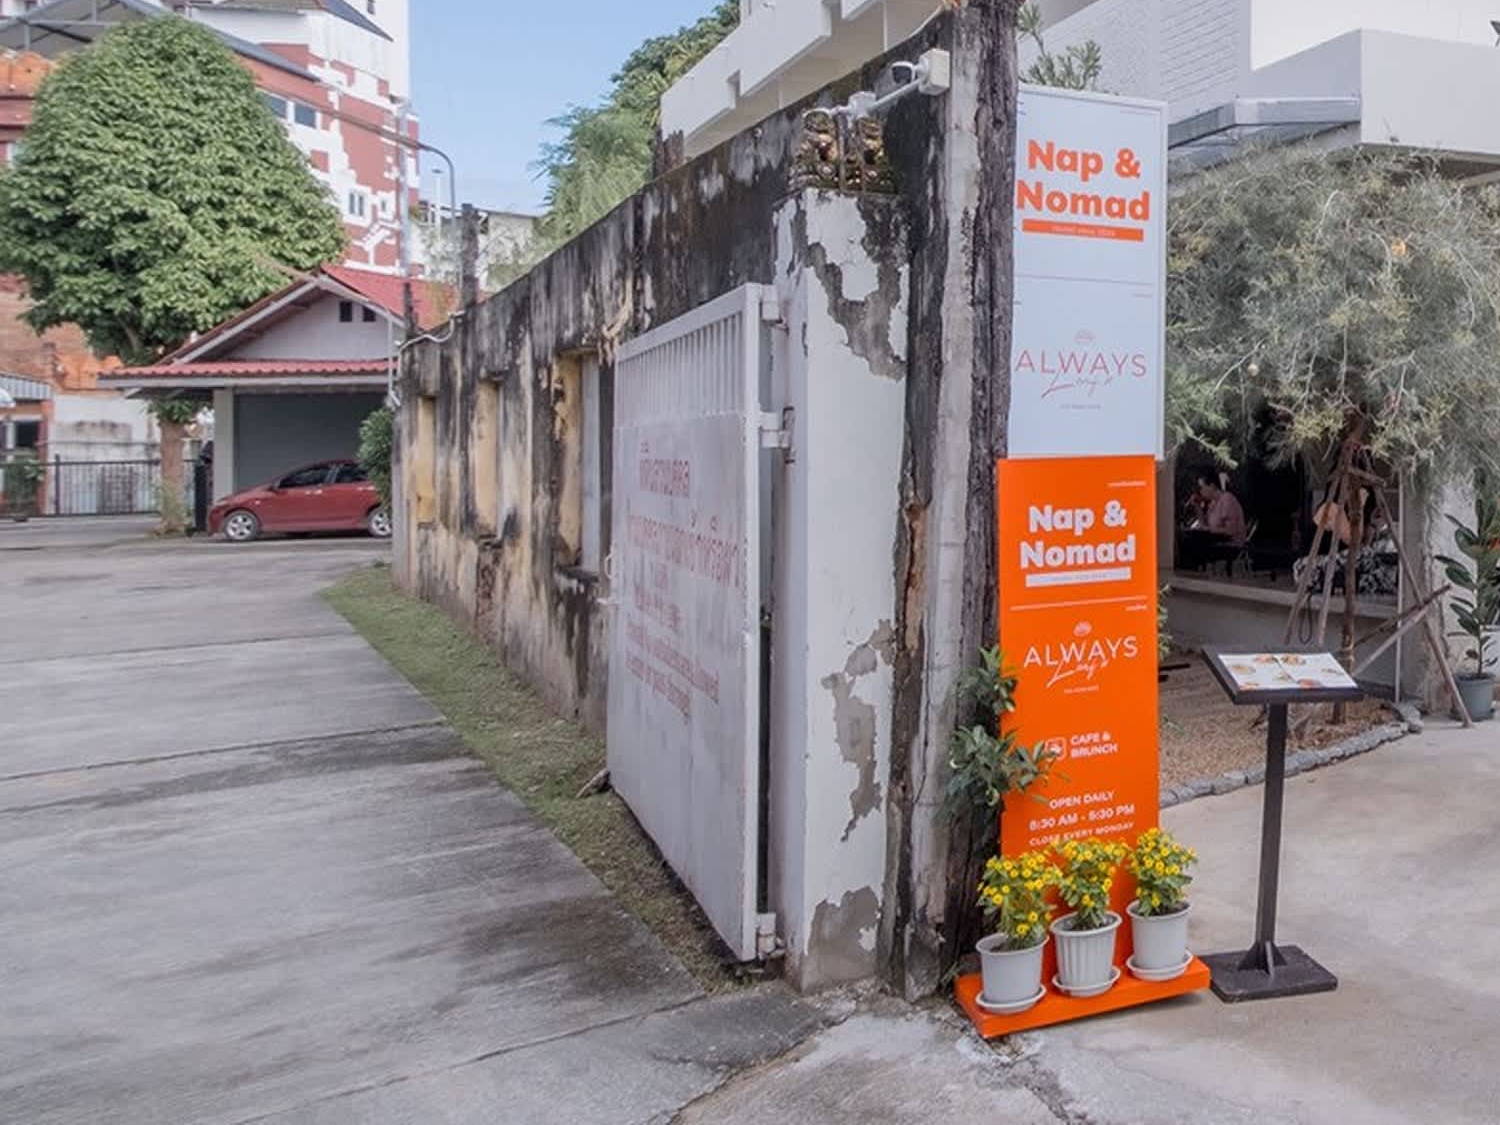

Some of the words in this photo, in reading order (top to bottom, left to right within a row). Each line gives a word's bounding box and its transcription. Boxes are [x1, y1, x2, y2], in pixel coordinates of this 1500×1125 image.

[1027, 139, 1104, 182] Nap
[1115, 148, 1141, 179] &
[1016, 179, 1150, 221] Nomad
[1015, 349, 1147, 378] ALWAYS
[1029, 504, 1095, 536] Nap
[1104, 499, 1127, 527] &
[1020, 533, 1136, 569] Nomad
[1023, 636, 1138, 668] ALWAYS
[1071, 733, 1100, 745] CAFE
[1071, 743, 1118, 758] BRUNCH
[1049, 795, 1081, 809] OPEN
[1083, 790, 1114, 804] DAILY
[1058, 812, 1078, 826] AM
[1116, 803, 1135, 816] PM
